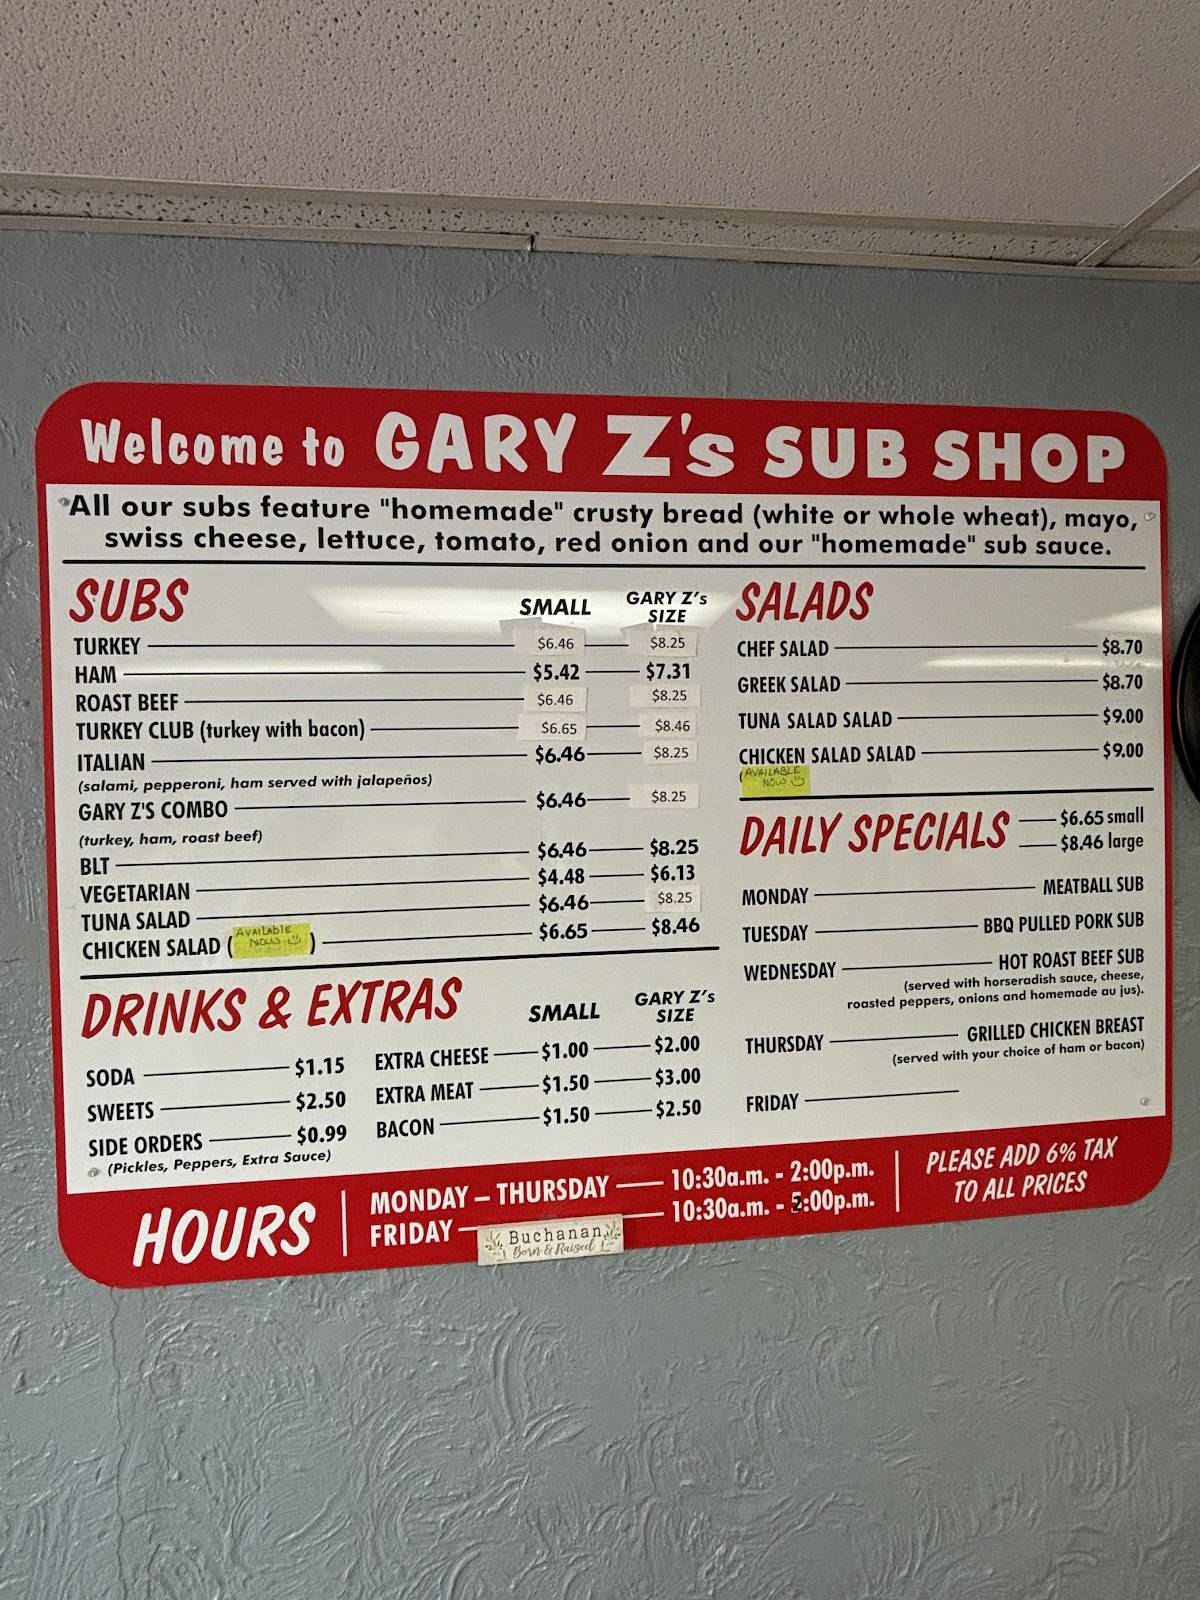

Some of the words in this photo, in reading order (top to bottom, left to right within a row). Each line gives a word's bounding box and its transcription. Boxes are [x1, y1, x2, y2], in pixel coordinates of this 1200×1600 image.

[81, 418, 283, 466] Welcome
[302, 427, 344, 467] to
[376, 412, 576, 473] GARY
[602, 413, 734, 477] Z's
[764, 426, 906, 478] SUB
[933, 430, 1125, 483] SHOP
[70, 494, 109, 516] All
[122, 501, 172, 516] our
[184, 495, 250, 517] subs
[261, 495, 369, 518] feature
[381, 497, 562, 521] "homemade"
[574, 505, 653, 528] crusty
[664, 502, 742, 523] bread
[754, 503, 833, 529] (white
[844, 511, 870, 524] or
[879, 504, 954, 525] whole
[963, 506, 1056, 531] wheat),
[1066, 514, 1136, 532] mayo,
[106, 526, 182, 547] swiss
[195, 526, 306, 552] cheese,
[318, 527, 425, 553] lettuce,
[435, 532, 544, 555] tomato,
[556, 531, 600, 552] red
[612, 532, 687, 552] onion
[698, 532, 748, 553] and
[759, 539, 803, 553] our
[812, 533, 975, 553] "homemade"
[985, 534, 1026, 554] sub
[1036, 541, 1111, 555] sauce.
[69, 578, 189, 622] SUBS
[520, 598, 591, 615] SMALL
[627, 592, 676, 604] GARY
[681, 592, 707, 604] Z's
[736, 581, 873, 622] SALADS
[648, 610, 686, 623] SIZE
[74, 638, 140, 655] TURKEY
[538, 637, 573, 650] $6.46
[651, 636, 685, 650] $8.25
[738, 641, 774, 657] CHEF
[780, 640, 828, 656] SALAD
[1103, 638, 1142, 656] $8.70
[76, 666, 116, 683] HAM
[534, 663, 579, 682] $5.42
[647, 662, 689, 681] $7.31
[76, 694, 131, 712] ROAST
[139, 694, 178, 711] BEEF
[76, 722, 143, 740] TURKEY
[149, 722, 193, 739] CLUB
[201, 720, 260, 743] (turkey
[266, 719, 301, 737] with
[309, 719, 364, 741] bacon)
[542, 721, 576, 734] $6.65
[656, 719, 690, 732] $8.46
[740, 748, 804, 765] CHICKEN
[812, 747, 860, 763] SALAD
[867, 746, 915, 762] SALAD
[1104, 742, 1143, 759] $9.00
[78, 753, 144, 771] ITALIAN
[744, 765, 801, 778] AVAILABLE
[79, 780, 138, 794] (salami,
[144, 778, 225, 793] pepperoni,
[231, 777, 262, 788] ham
[268, 776, 317, 787] served
[322, 775, 352, 786] with
[357, 774, 432, 789] jalapeños)
[762, 777, 788, 788] NOW
[79, 803, 125, 821] GARY
[131, 802, 154, 819] Z'S
[161, 801, 227, 819] COMBO
[1061, 809, 1103, 827] $6.65
[1108, 807, 1143, 823] small
[80, 834, 134, 848] (turkey,
[140, 833, 176, 845] ham,
[182, 833, 220, 843] roast
[225, 830, 262, 843] beef)
[740, 813, 843, 856] DAILY
[848, 811, 1009, 852] SPECIALS
[81, 857, 109, 875] BLT
[651, 864, 694, 883] $6.13
[539, 868, 584, 887] $4.48
[1044, 877, 1112, 895] MEATBALL
[1117, 876, 1143, 892] SUB
[80, 883, 189, 903] VEGETARIAN
[743, 888, 808, 905] MONDAY
[81, 913, 130, 931] TUNA
[136, 911, 190, 929] SALAD
[984, 917, 1013, 933] BBQ
[1020, 915, 1070, 932] PULLED
[1076, 913, 1113, 929] PORK
[1117, 912, 1144, 927] SUB
[743, 925, 808, 943] TUESDAY
[83, 940, 160, 960] CHICKEN
[167, 938, 220, 956] SALAD
[1000, 954, 1028, 970] HOT
[1033, 951, 1076, 968] ROAST
[1082, 950, 1112, 966] BEEF
[1118, 948, 1144, 964] SUB
[744, 962, 836, 981] WEDNESDAY
[904, 979, 949, 993] (served
[954, 977, 979, 988] with
[985, 973, 1056, 987] horseradish
[1060, 975, 1097, 983] sauce,
[1101, 971, 1144, 981] cheese,
[848, 997, 894, 1009] roasted
[900, 997, 954, 1009] peppers,
[959, 993, 999, 1003] onions
[1003, 990, 1026, 1001] and
[1031, 987, 1097, 999] homemade
[1120, 984, 1144, 997] jus).
[82, 988, 246, 1038] DRINKS
[259, 986, 290, 1029] &
[308, 977, 462, 1026] EXTRAS
[968, 1024, 1025, 1042] GRILLED
[1030, 1020, 1090, 1038] CHICKEN
[1096, 1017, 1144, 1034] BREAST
[543, 1042, 588, 1061] $1.00
[655, 1036, 699, 1055] $2.00
[746, 1035, 823, 1054] THURSDAY
[893, 1051, 938, 1066] (served
[942, 1050, 968, 1060] with
[972, 1051, 999, 1062] your
[1004, 1046, 1040, 1057] choice
[1044, 1044, 1055, 1054] of
[1060, 1044, 1085, 1053] ham
[1106, 1039, 1144, 1050] bacon)
[296, 1057, 344, 1078] $1.15
[376, 1051, 424, 1070] EXTRA
[431, 1047, 488, 1066] CHEESE
[87, 1068, 134, 1087] SODA
[297, 1091, 345, 1112] $2.50
[88, 1102, 153, 1122] SWEETS
[108, 1161, 168, 1176] (Pickles,
[174, 1159, 236, 1171] Peppers,
[243, 1155, 278, 1165] Extra
[284, 1150, 330, 1162] Sauce)
[926, 1147, 996, 1174] PLEASE
[1000, 1143, 1040, 1168] ADD
[1047, 1143, 1076, 1163] 6%
[1084, 1136, 1118, 1161] TAX
[672, 1166, 769, 1190] 10:30a.m.
[791, 1158, 874, 1184] 2:00p.m.
[371, 1186, 468, 1214] MONDAY
[497, 1176, 609, 1205] THURSDAY
[955, 1180, 978, 1202] TO
[982, 1177, 1014, 1201] ALL
[1022, 1170, 1087, 1197] PRICES
[133, 1202, 316, 1267] HOURS
[509, 1224, 603, 1246] Buchanan
